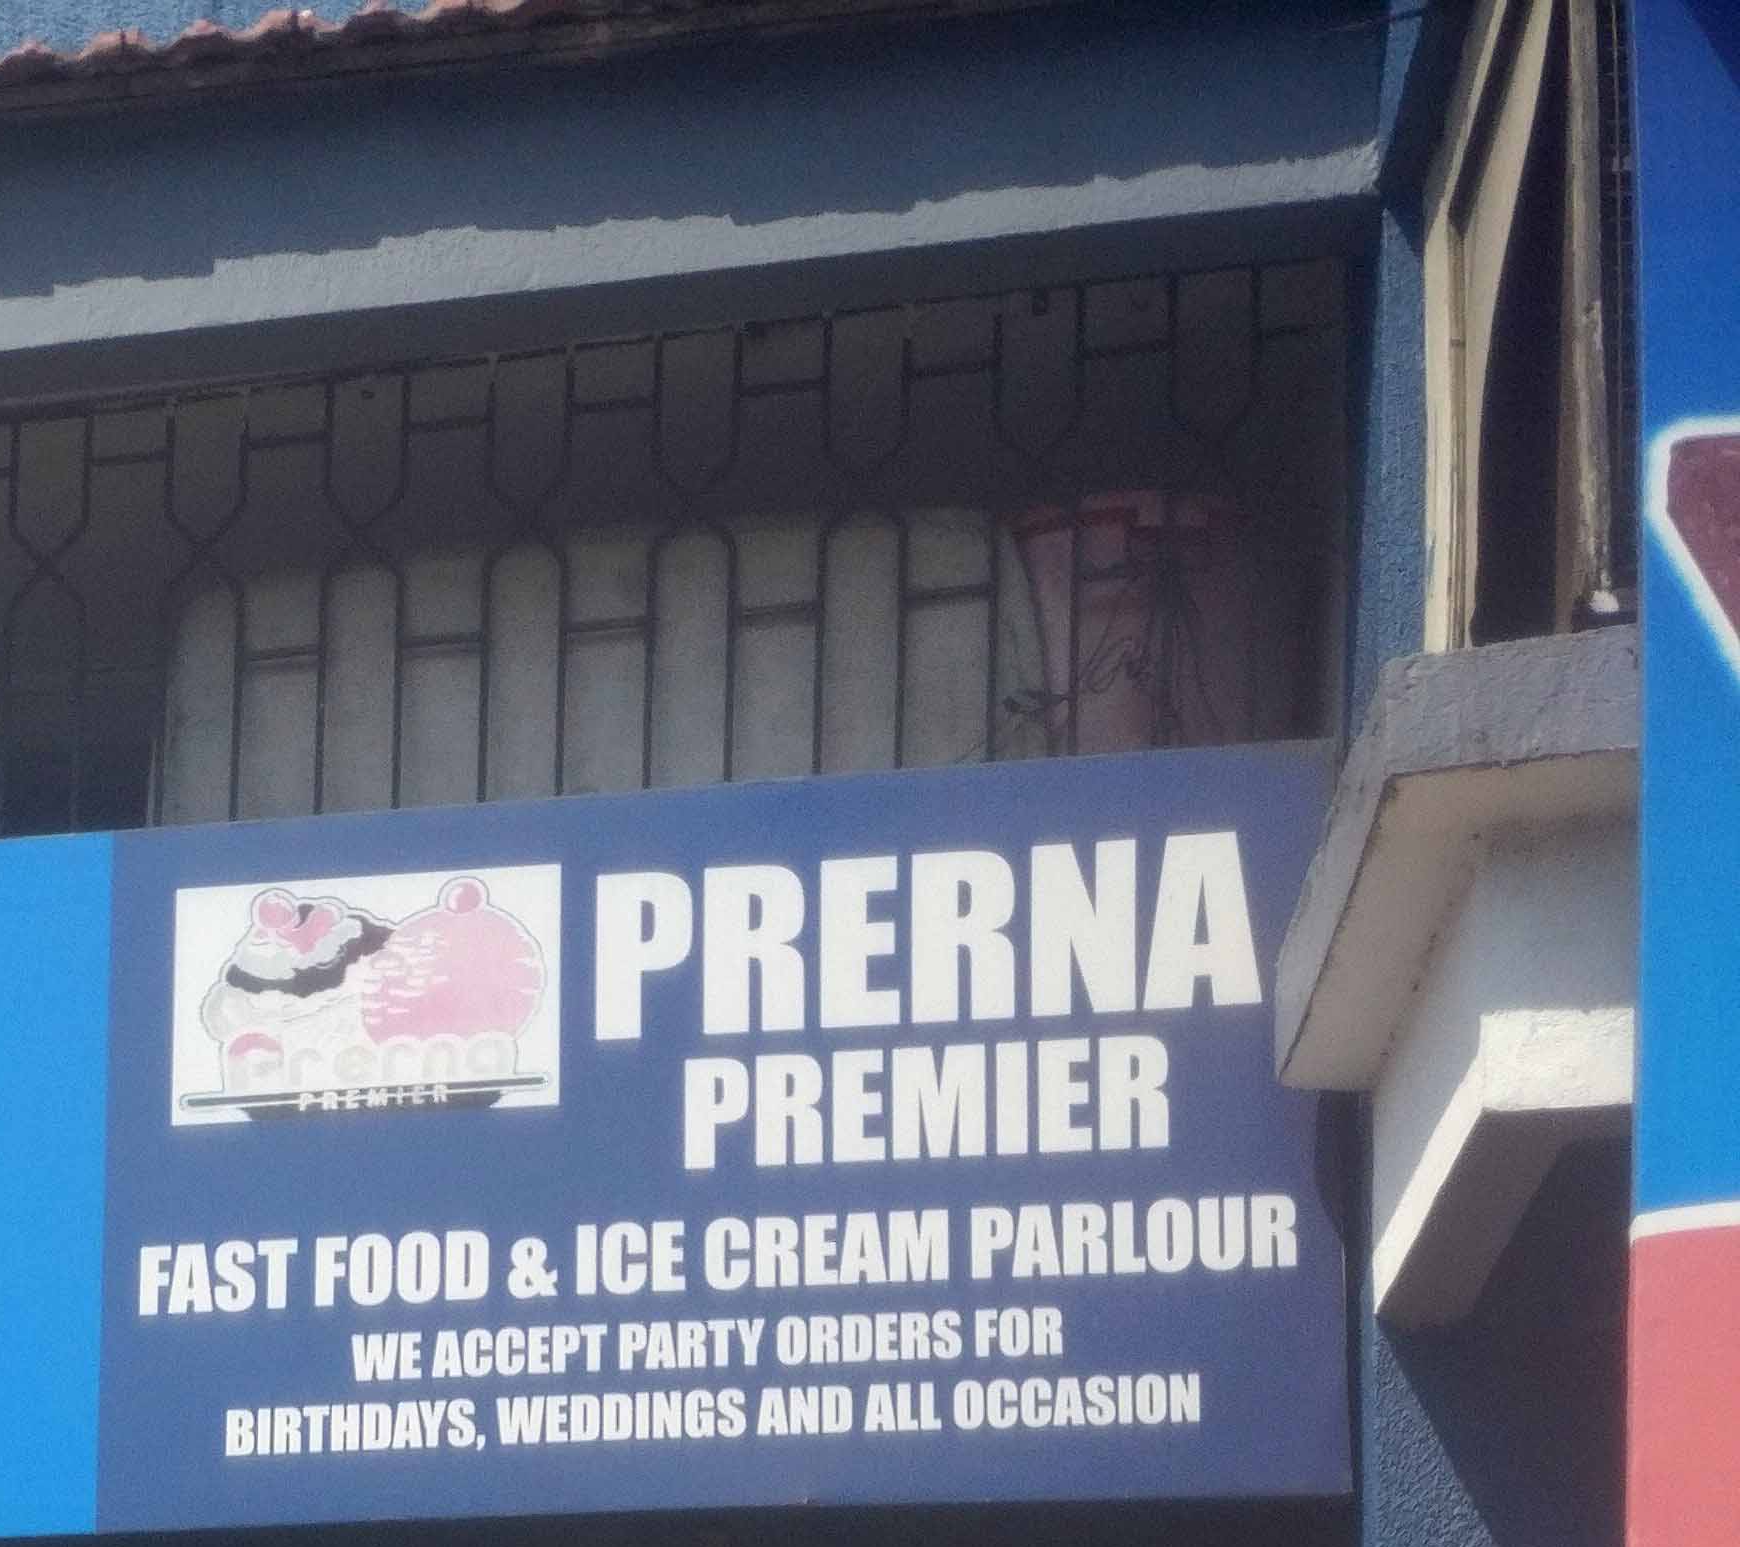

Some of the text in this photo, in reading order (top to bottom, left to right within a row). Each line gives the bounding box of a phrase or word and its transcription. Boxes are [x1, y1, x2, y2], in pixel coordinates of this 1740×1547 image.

[595, 831, 1263, 1042] PRERNA
[299, 1083, 450, 1113] PREMIER
[683, 1034, 1170, 1170] PREMIER
[138, 1194, 1297, 1316] FAST FOOD & ICE CREAM PARLOUR
[351, 1306, 1064, 1382] WE ACCEPT PARTY ORDERS FOR
[225, 1372, 1201, 1457] BIRTHDAYS, WEDDINGS AND ALL OCCASION
